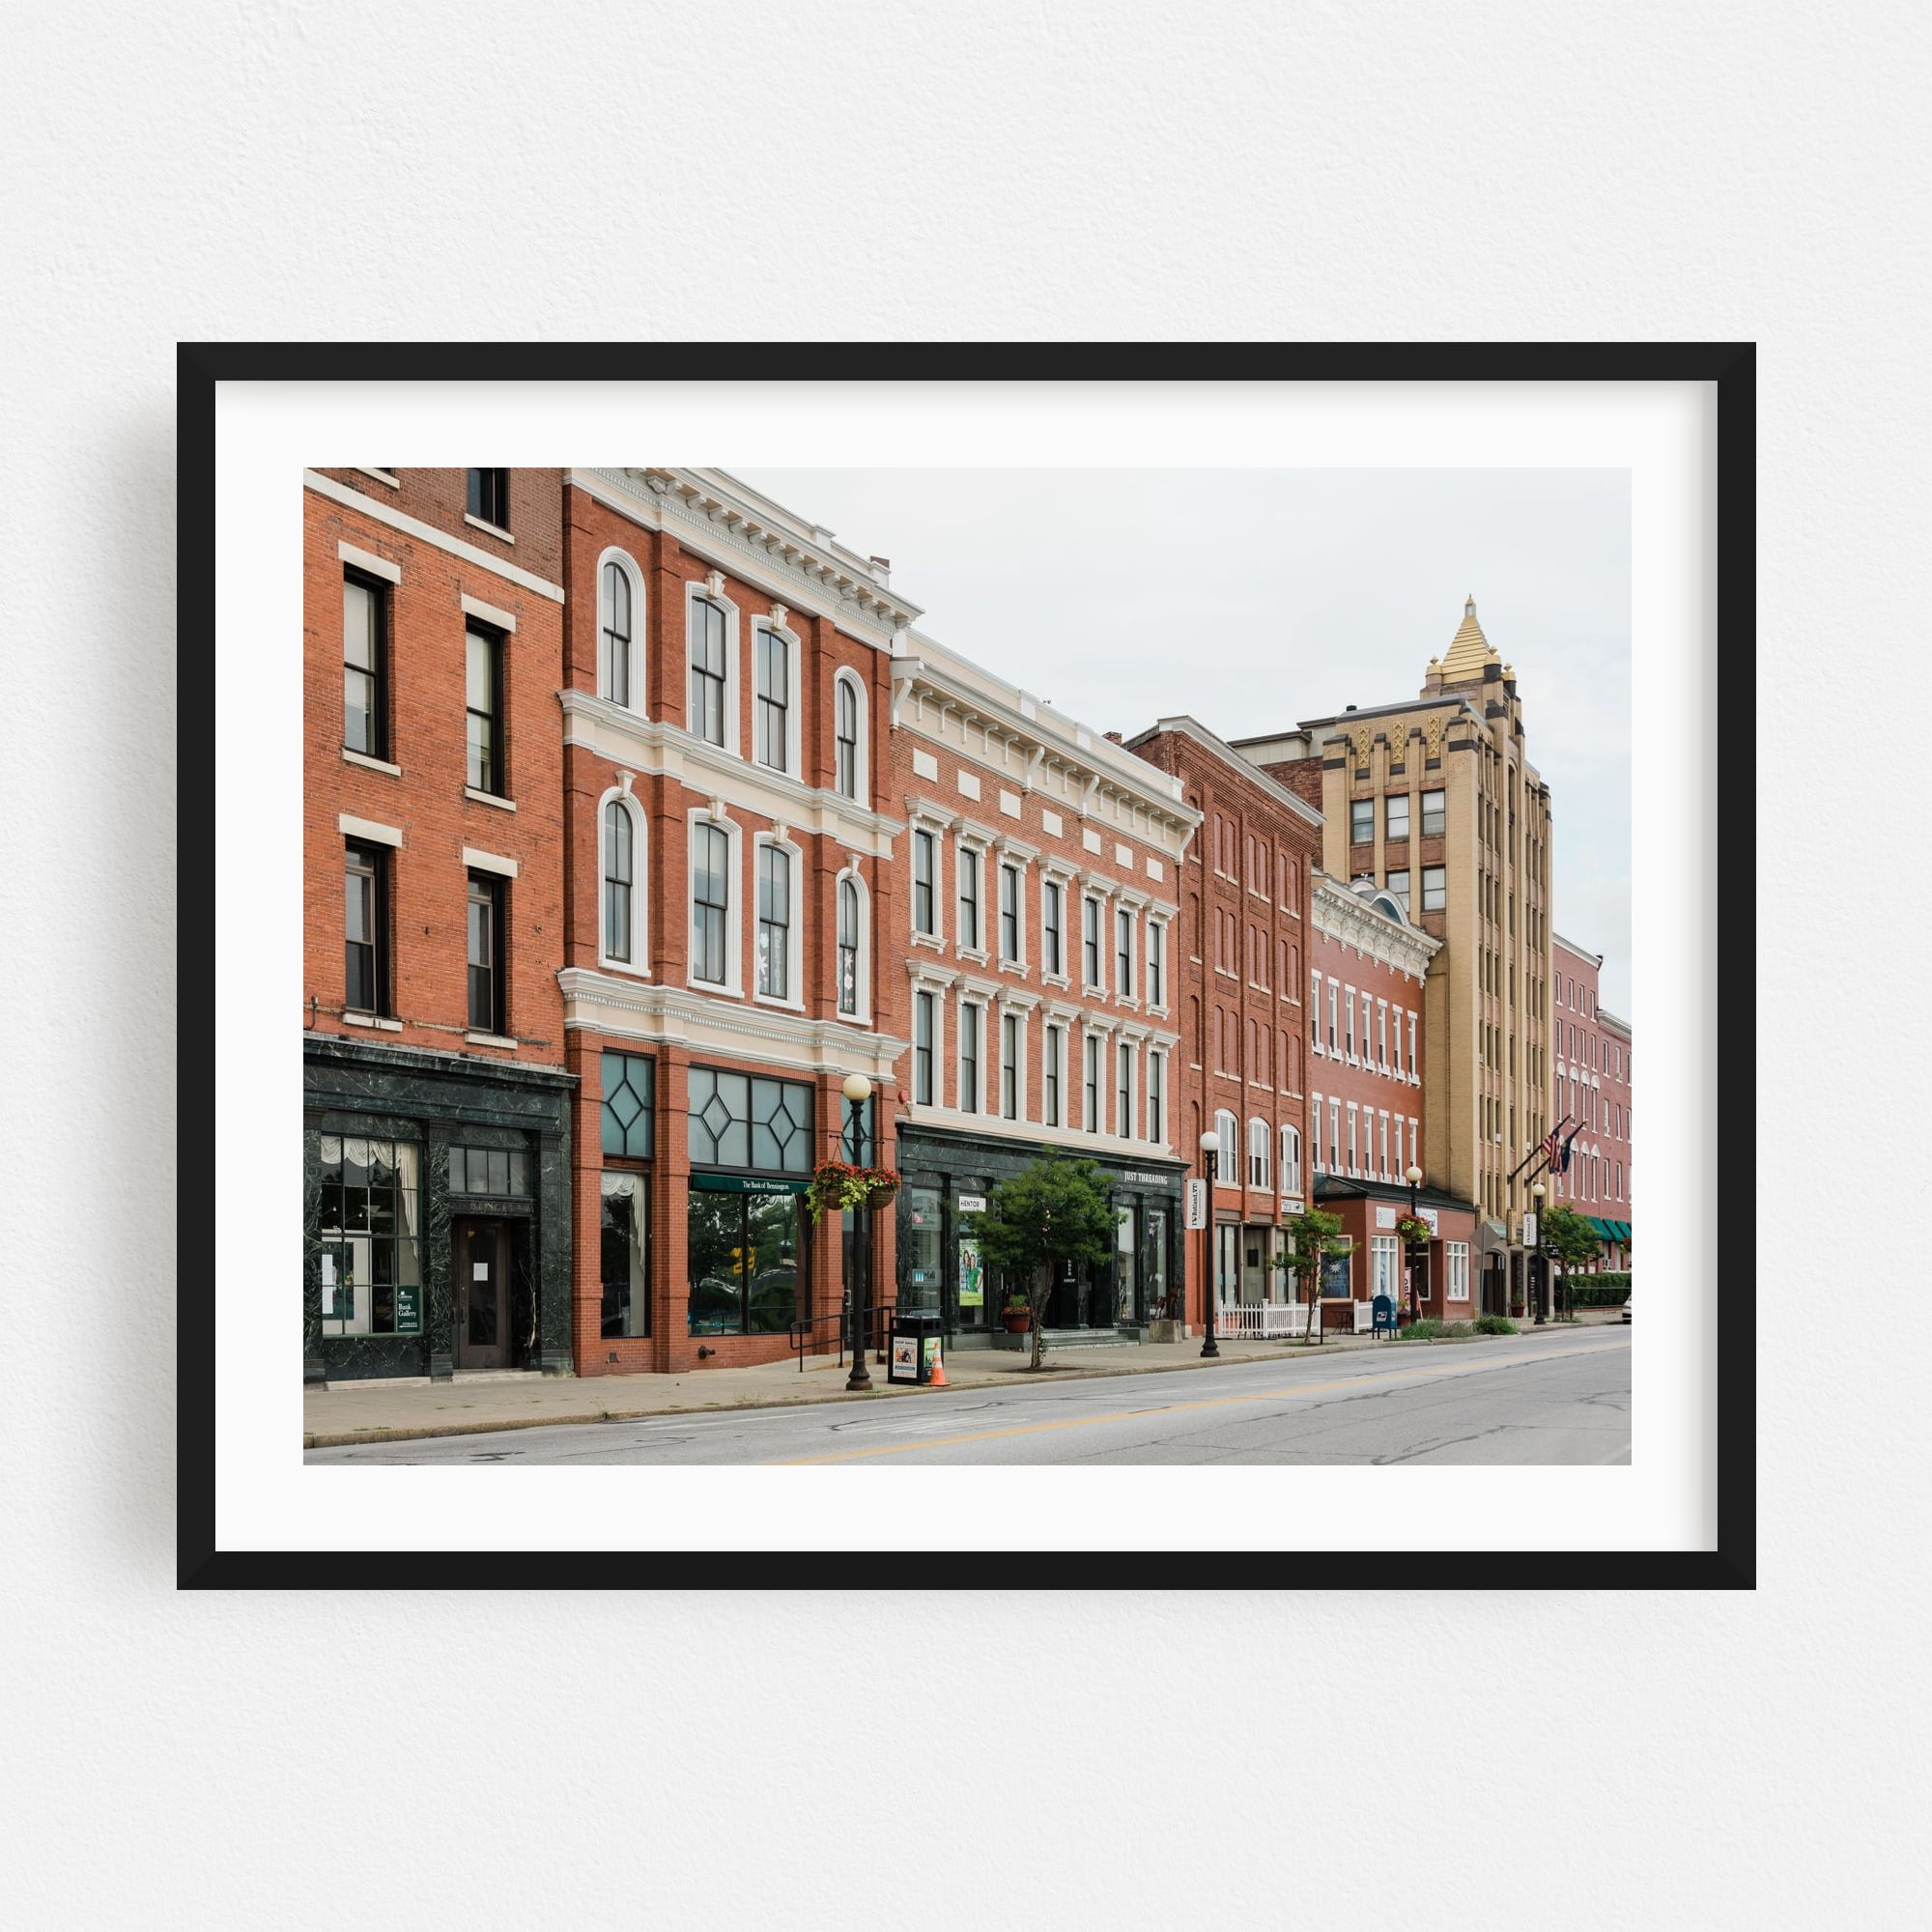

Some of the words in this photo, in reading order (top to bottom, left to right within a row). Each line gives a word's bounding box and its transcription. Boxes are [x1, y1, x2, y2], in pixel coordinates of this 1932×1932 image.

[1124, 1171, 1137, 1182] JUST
[1138, 1173, 1168, 1185] THREADING
[398, 1309, 416, 1319] Gallery
